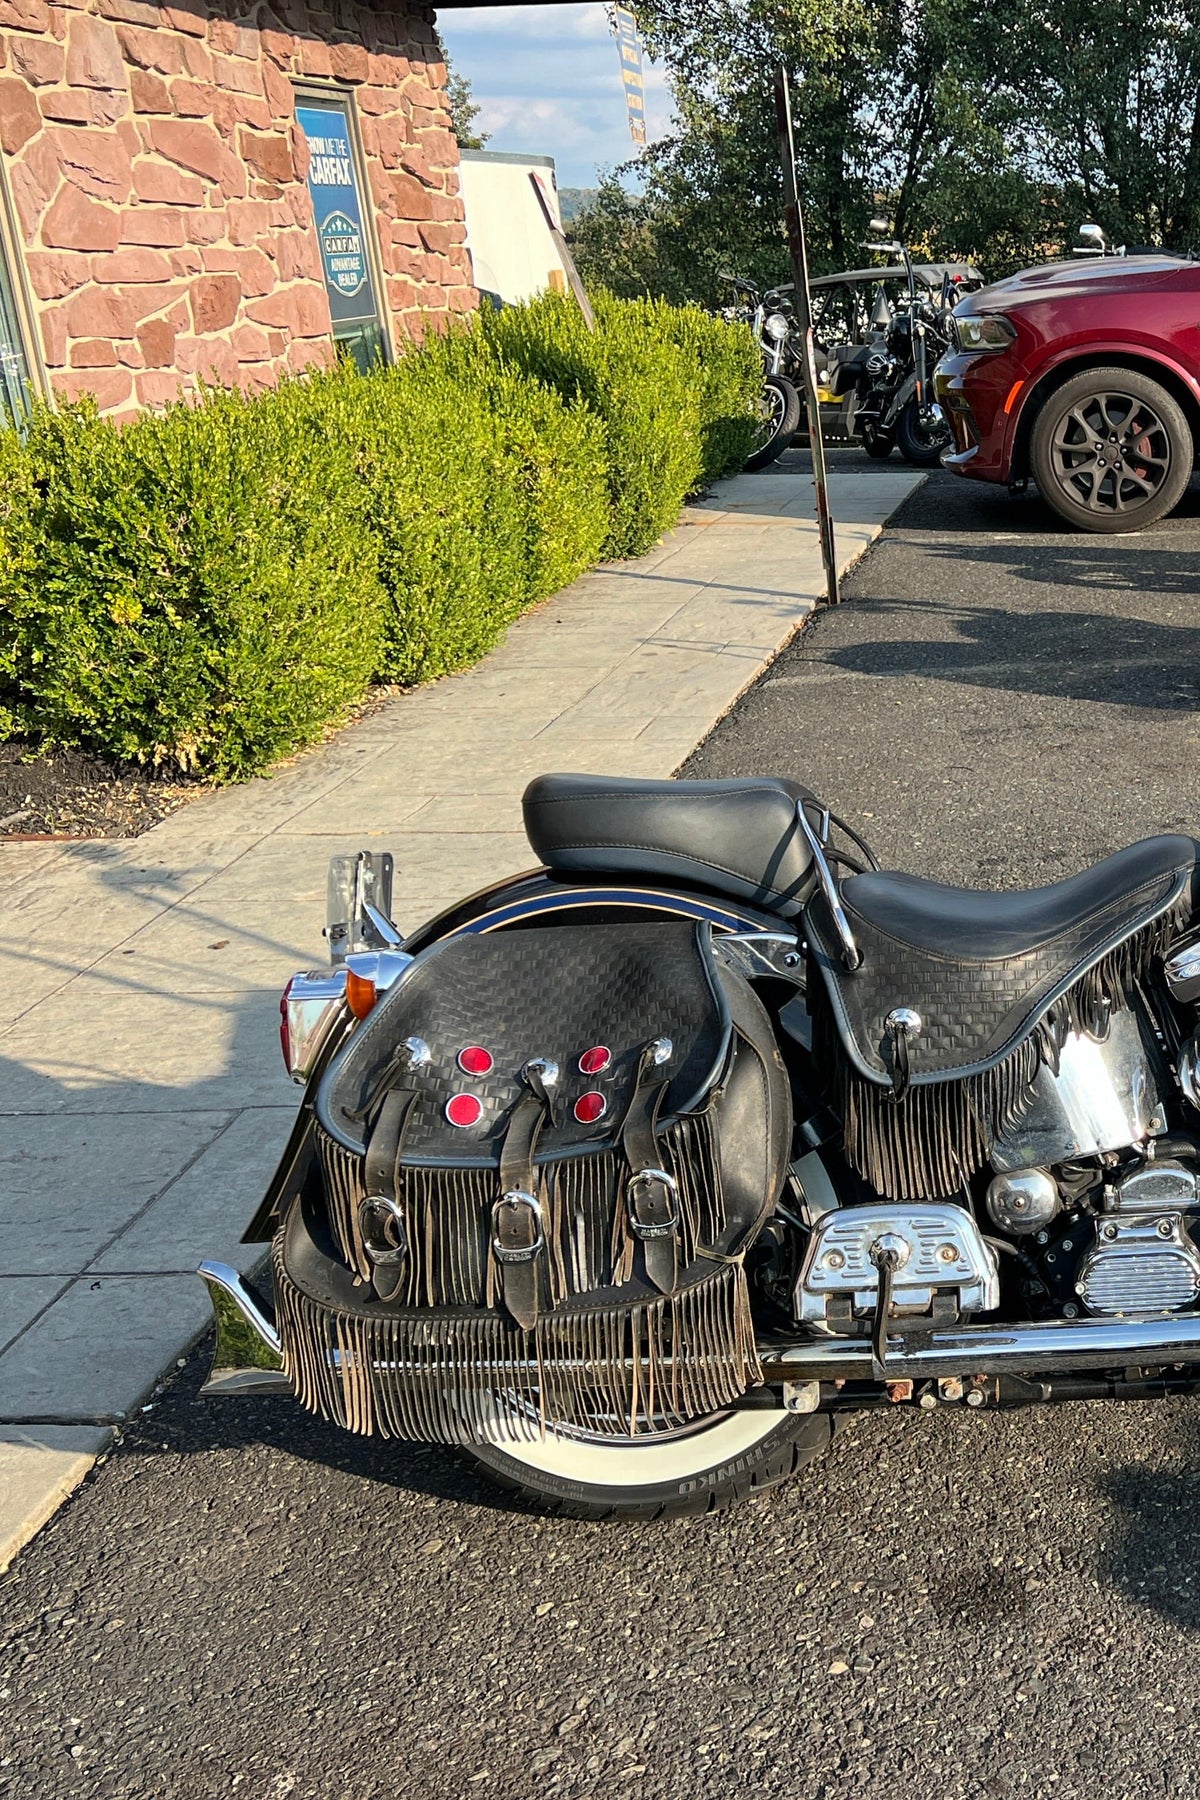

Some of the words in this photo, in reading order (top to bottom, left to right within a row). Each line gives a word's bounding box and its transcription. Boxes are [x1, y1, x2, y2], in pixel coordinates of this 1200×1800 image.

[324, 137, 336, 155] ME
[334, 138, 347, 156] THE
[309, 155, 352, 185] CARFAX
[325, 236, 360, 254] CARFAX
[331, 257, 360, 271] ADVANTAGE
[337, 272, 359, 286] DEALER
[678, 1433, 780, 1495] SHINKO
